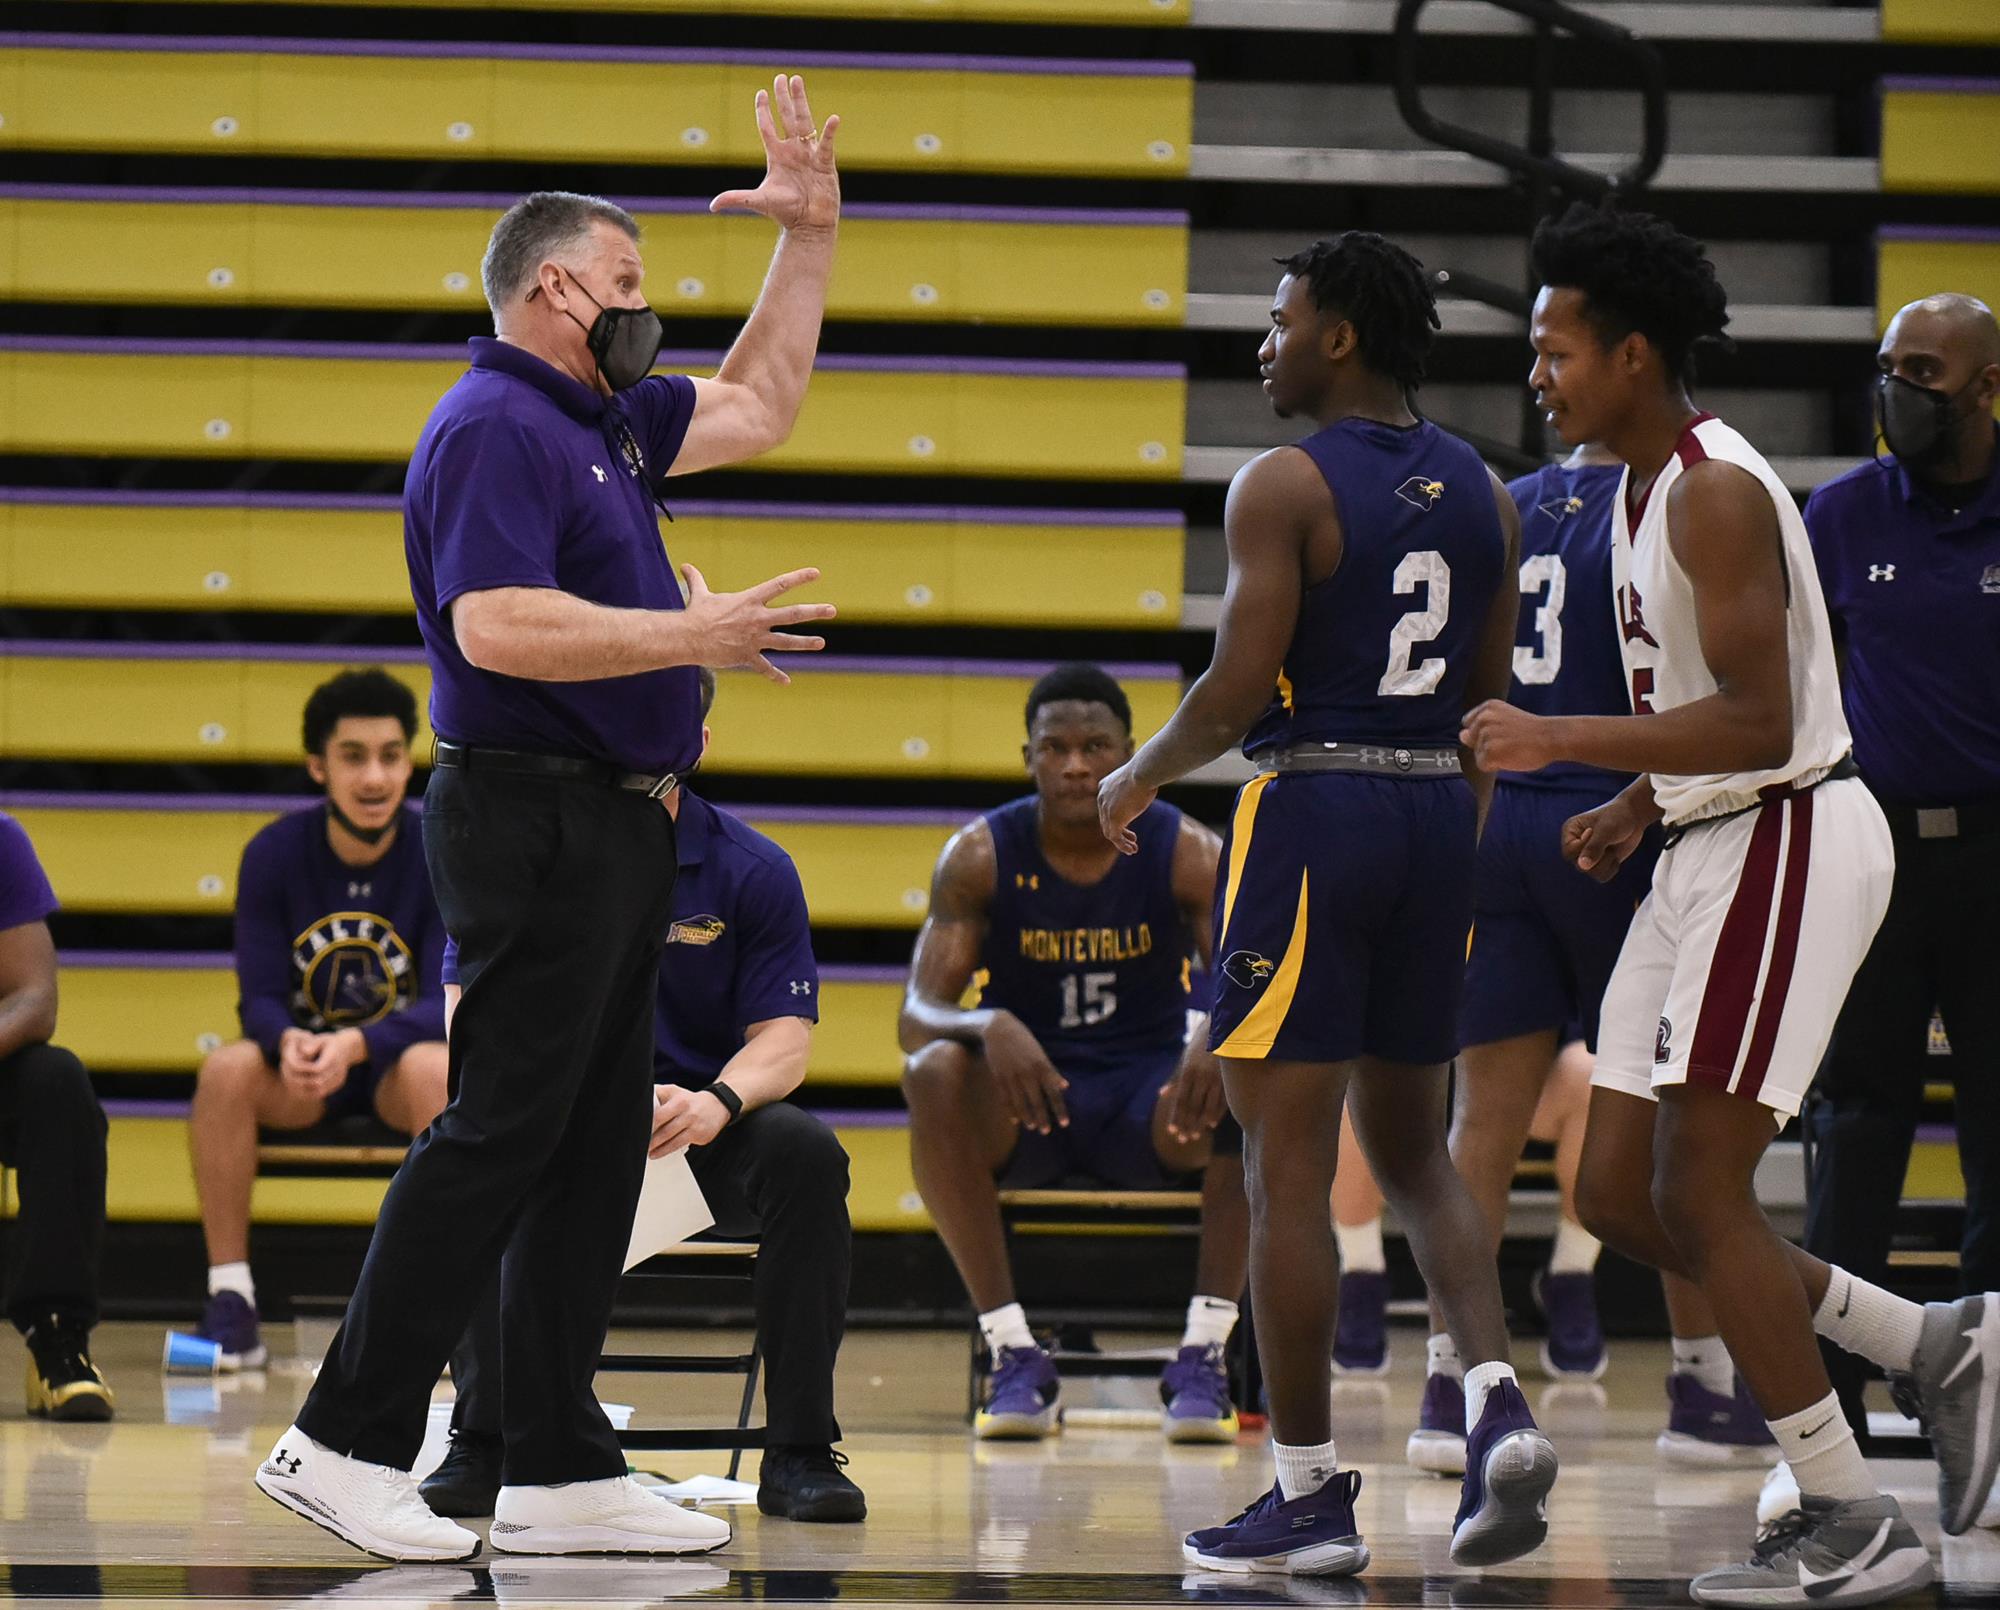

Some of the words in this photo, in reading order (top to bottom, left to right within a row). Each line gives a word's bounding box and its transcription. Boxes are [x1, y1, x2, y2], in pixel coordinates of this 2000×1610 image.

[1377, 550, 1451, 696] 2
[1512, 554, 1566, 684] 3
[1019, 923, 1152, 962] MONTEVALLO
[1060, 971, 1118, 1028] 15
